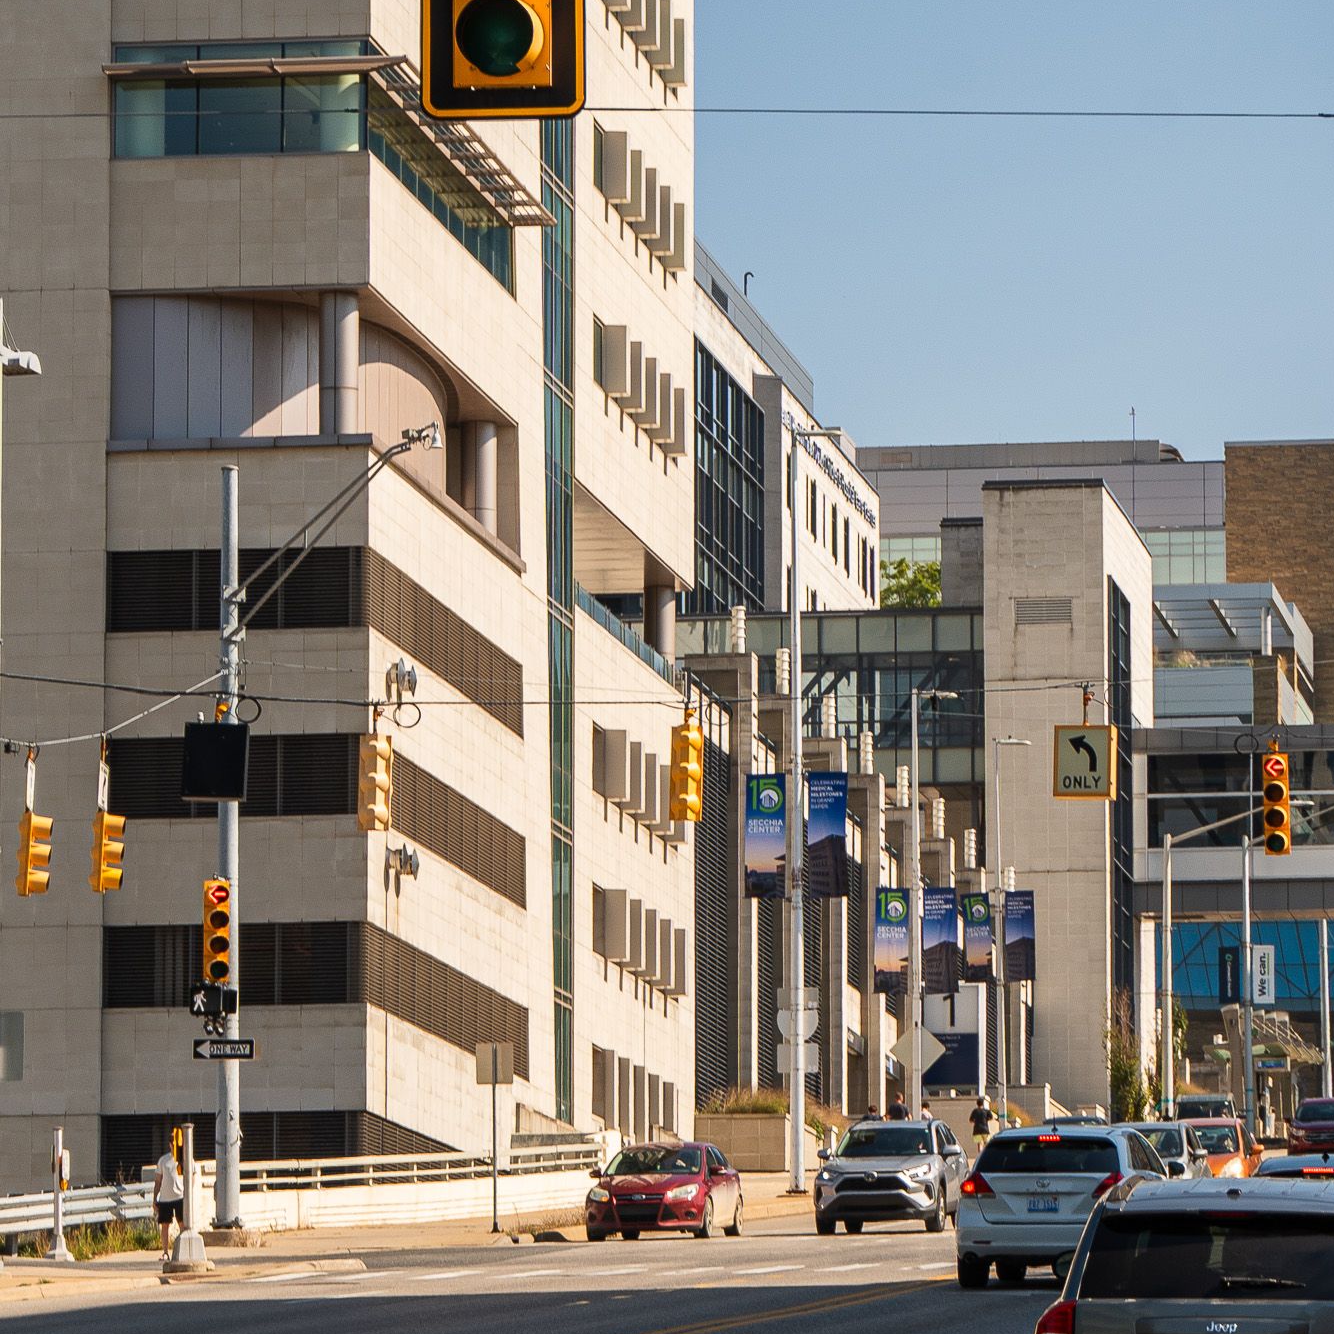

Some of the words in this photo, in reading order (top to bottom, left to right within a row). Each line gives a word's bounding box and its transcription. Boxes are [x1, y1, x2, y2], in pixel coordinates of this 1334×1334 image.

[1062, 775, 1101, 789] ONLY
[750, 779, 784, 813] 15
[748, 819, 783, 827] SECCHIA
[748, 826, 780, 834] CENTER
[879, 892, 907, 923] 15
[1258, 978, 1267, 997] We
[209, 1043, 226, 1054] ONE
[229, 1043, 247, 1054] WAY
[1206, 1320, 1238, 1334] Jeep
